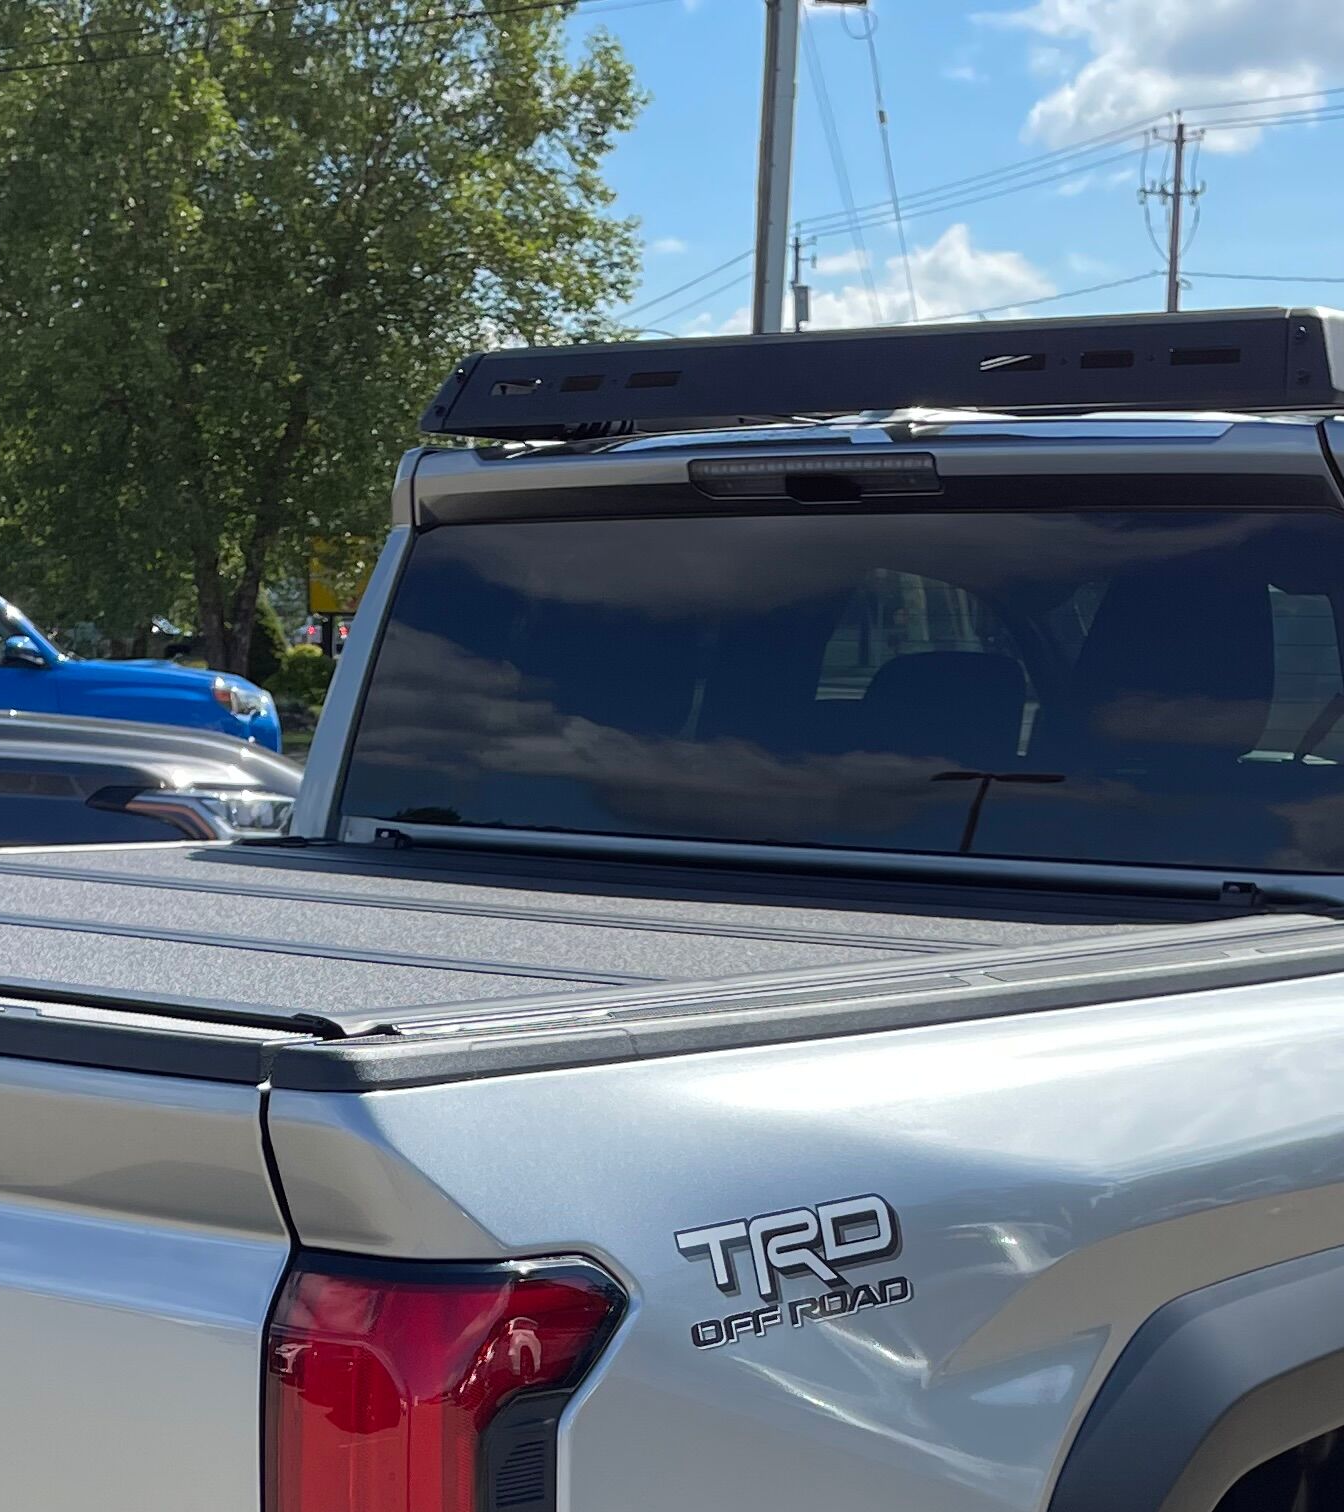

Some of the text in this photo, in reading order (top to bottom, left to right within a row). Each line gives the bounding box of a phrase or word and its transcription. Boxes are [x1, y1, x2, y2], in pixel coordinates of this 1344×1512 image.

[673, 1192, 902, 1304] TRD
[691, 1276, 914, 1350] OFF ROAD
